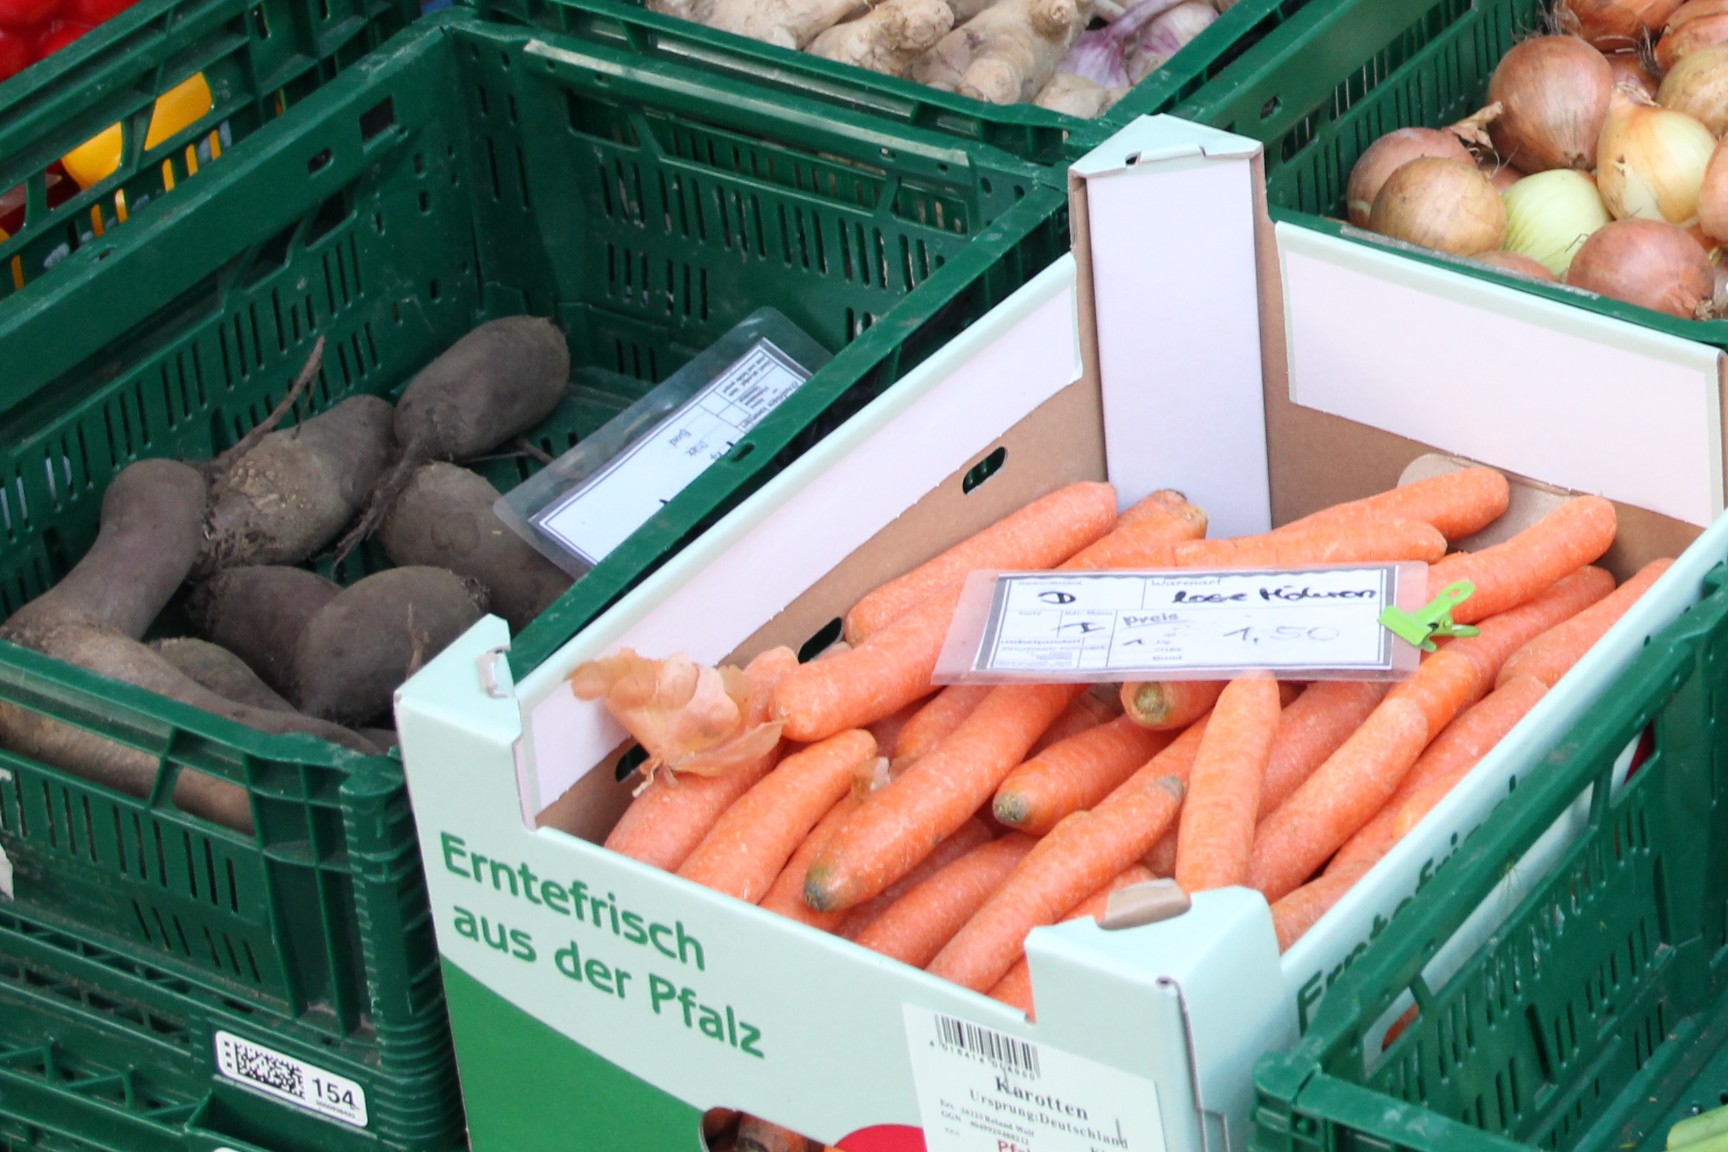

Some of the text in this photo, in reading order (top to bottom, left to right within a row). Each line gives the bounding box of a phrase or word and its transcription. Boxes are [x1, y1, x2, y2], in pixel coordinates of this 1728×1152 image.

[440, 830, 705, 972] Erntefrisch
[453, 904, 766, 1060] aus der Pfalz
[311, 1077, 357, 1106] 154
[994, 1075, 1089, 1121] Karotten
